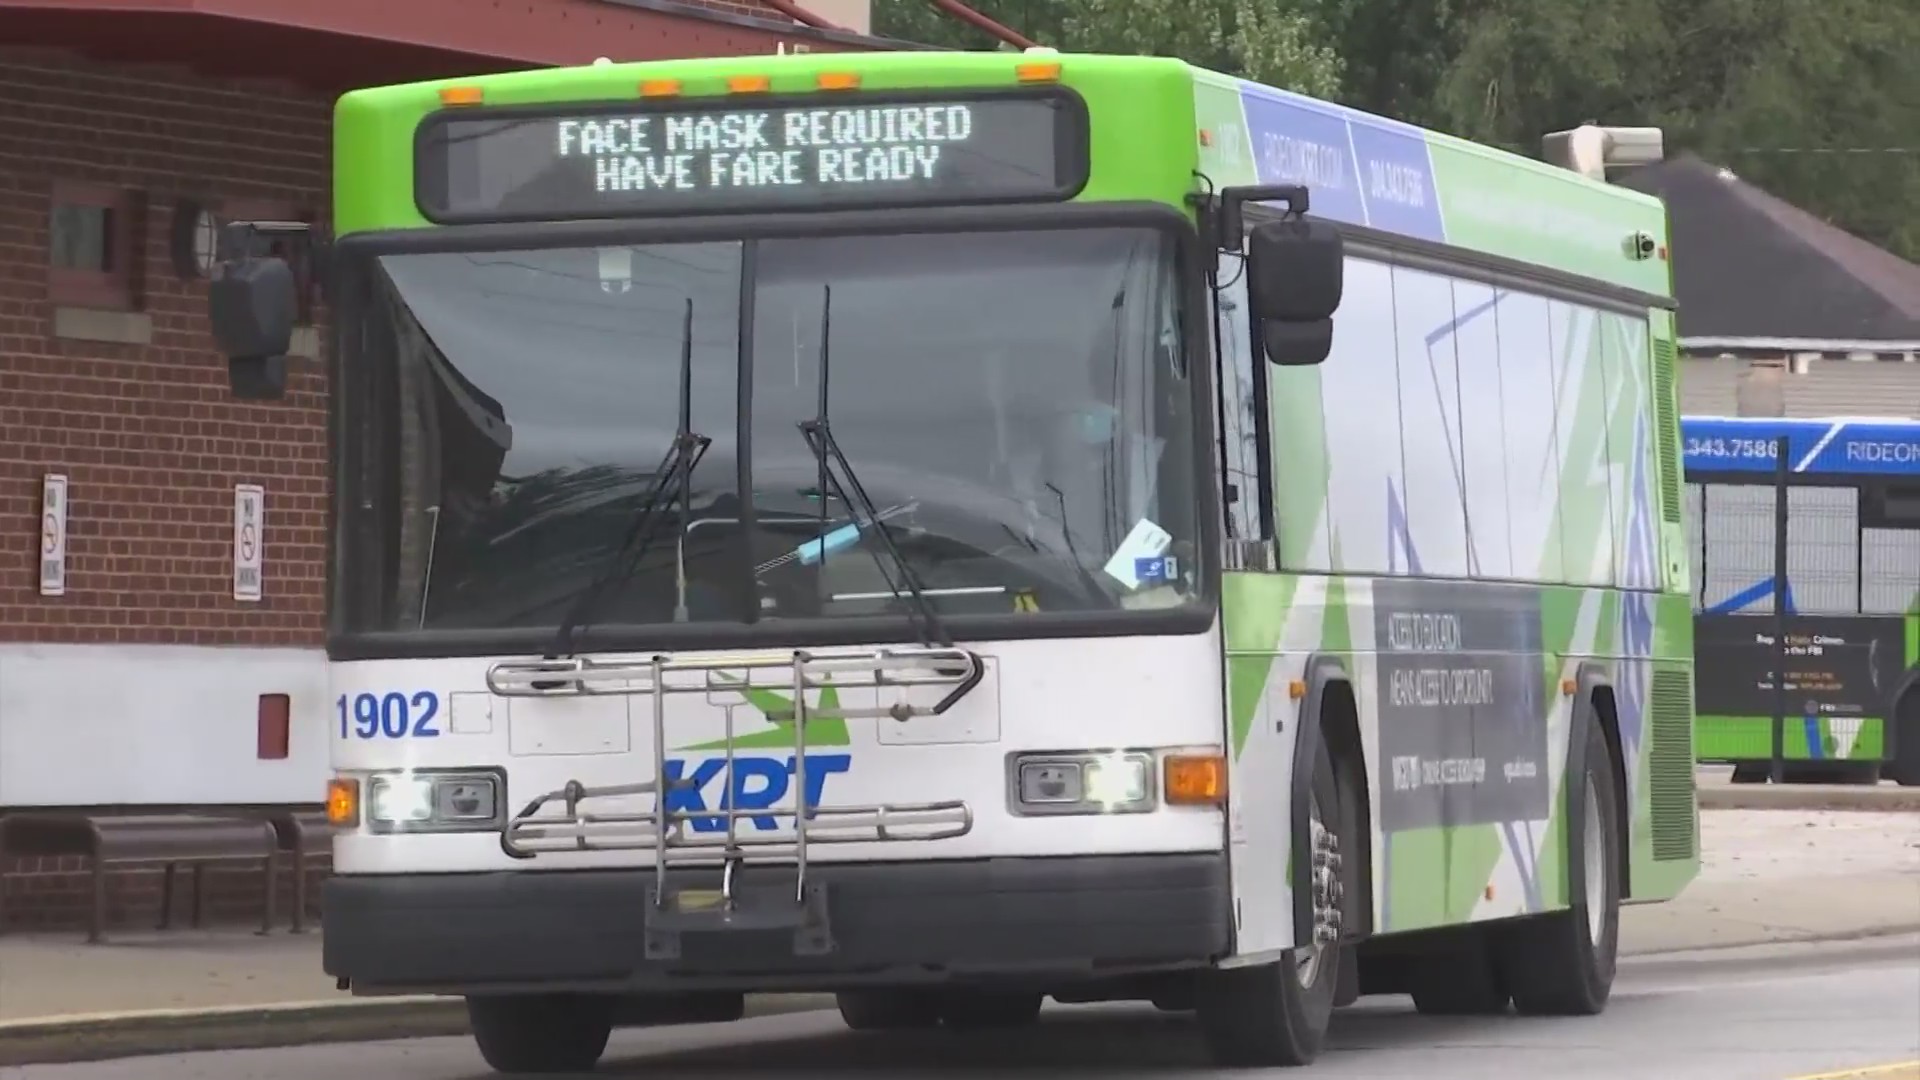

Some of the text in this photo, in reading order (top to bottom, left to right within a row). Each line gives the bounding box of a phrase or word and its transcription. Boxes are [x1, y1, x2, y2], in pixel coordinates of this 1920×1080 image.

[559, 105, 972, 155] FACE MASK REQUIRED
[596, 145, 940, 191] HAVE FARE READY
[336, 690, 440, 739] 1902
[652, 755, 851, 833] KRT
